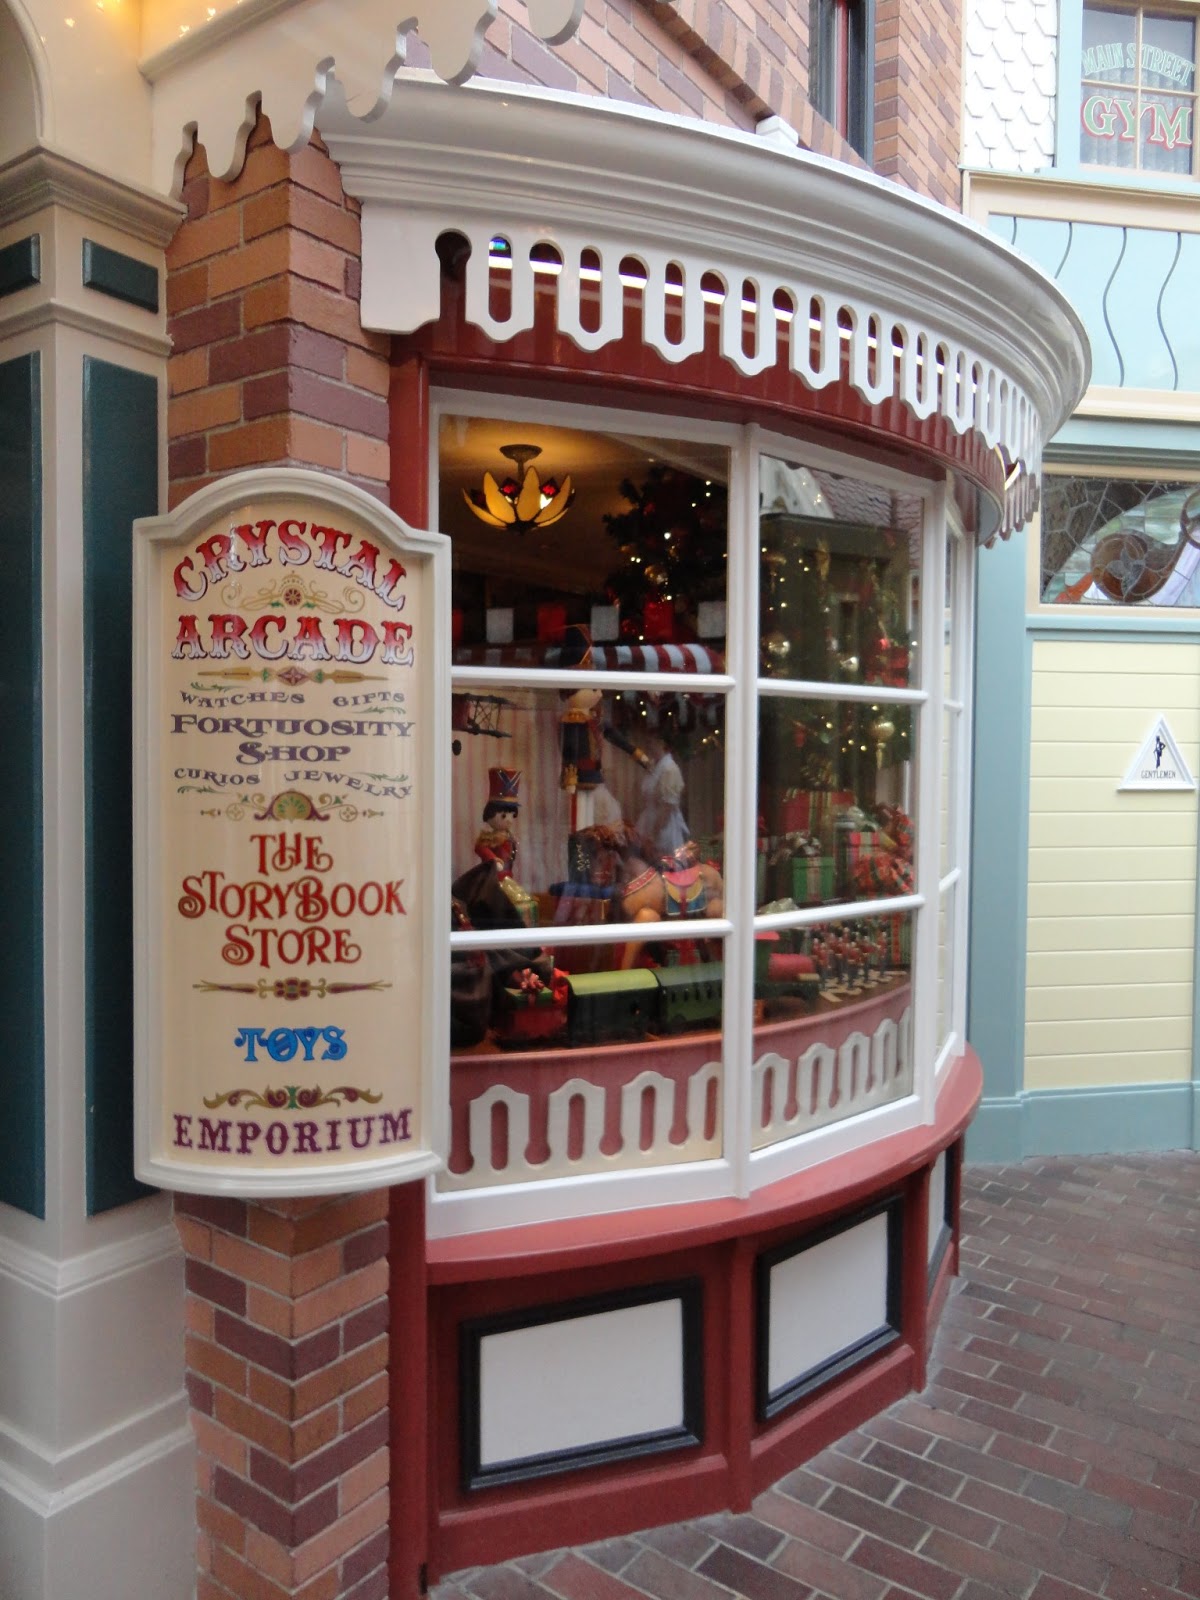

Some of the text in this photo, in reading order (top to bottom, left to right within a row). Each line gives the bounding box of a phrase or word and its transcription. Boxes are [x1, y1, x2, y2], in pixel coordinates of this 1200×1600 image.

[1082, 43, 1196, 86] MAIN STREET
[1081, 96, 1193, 152] GYM
[173, 519, 407, 611] CRYSTAL
[171, 614, 414, 667] ARCADE
[180, 690, 405, 708] WATCHES GIFTS
[171, 714, 416, 738] FORTUOSITY
[235, 741, 351, 765] SHOP
[1141, 770, 1176, 779] GENTLEMEN
[174, 768, 413, 799] CURIOS JEWELRY
[250, 832, 333, 875] THE
[178, 870, 408, 923] STORYBOOK
[222, 924, 362, 969] STORE
[234, 1025, 348, 1062] TOYS
[173, 1109, 413, 1156] EMPORIUM
